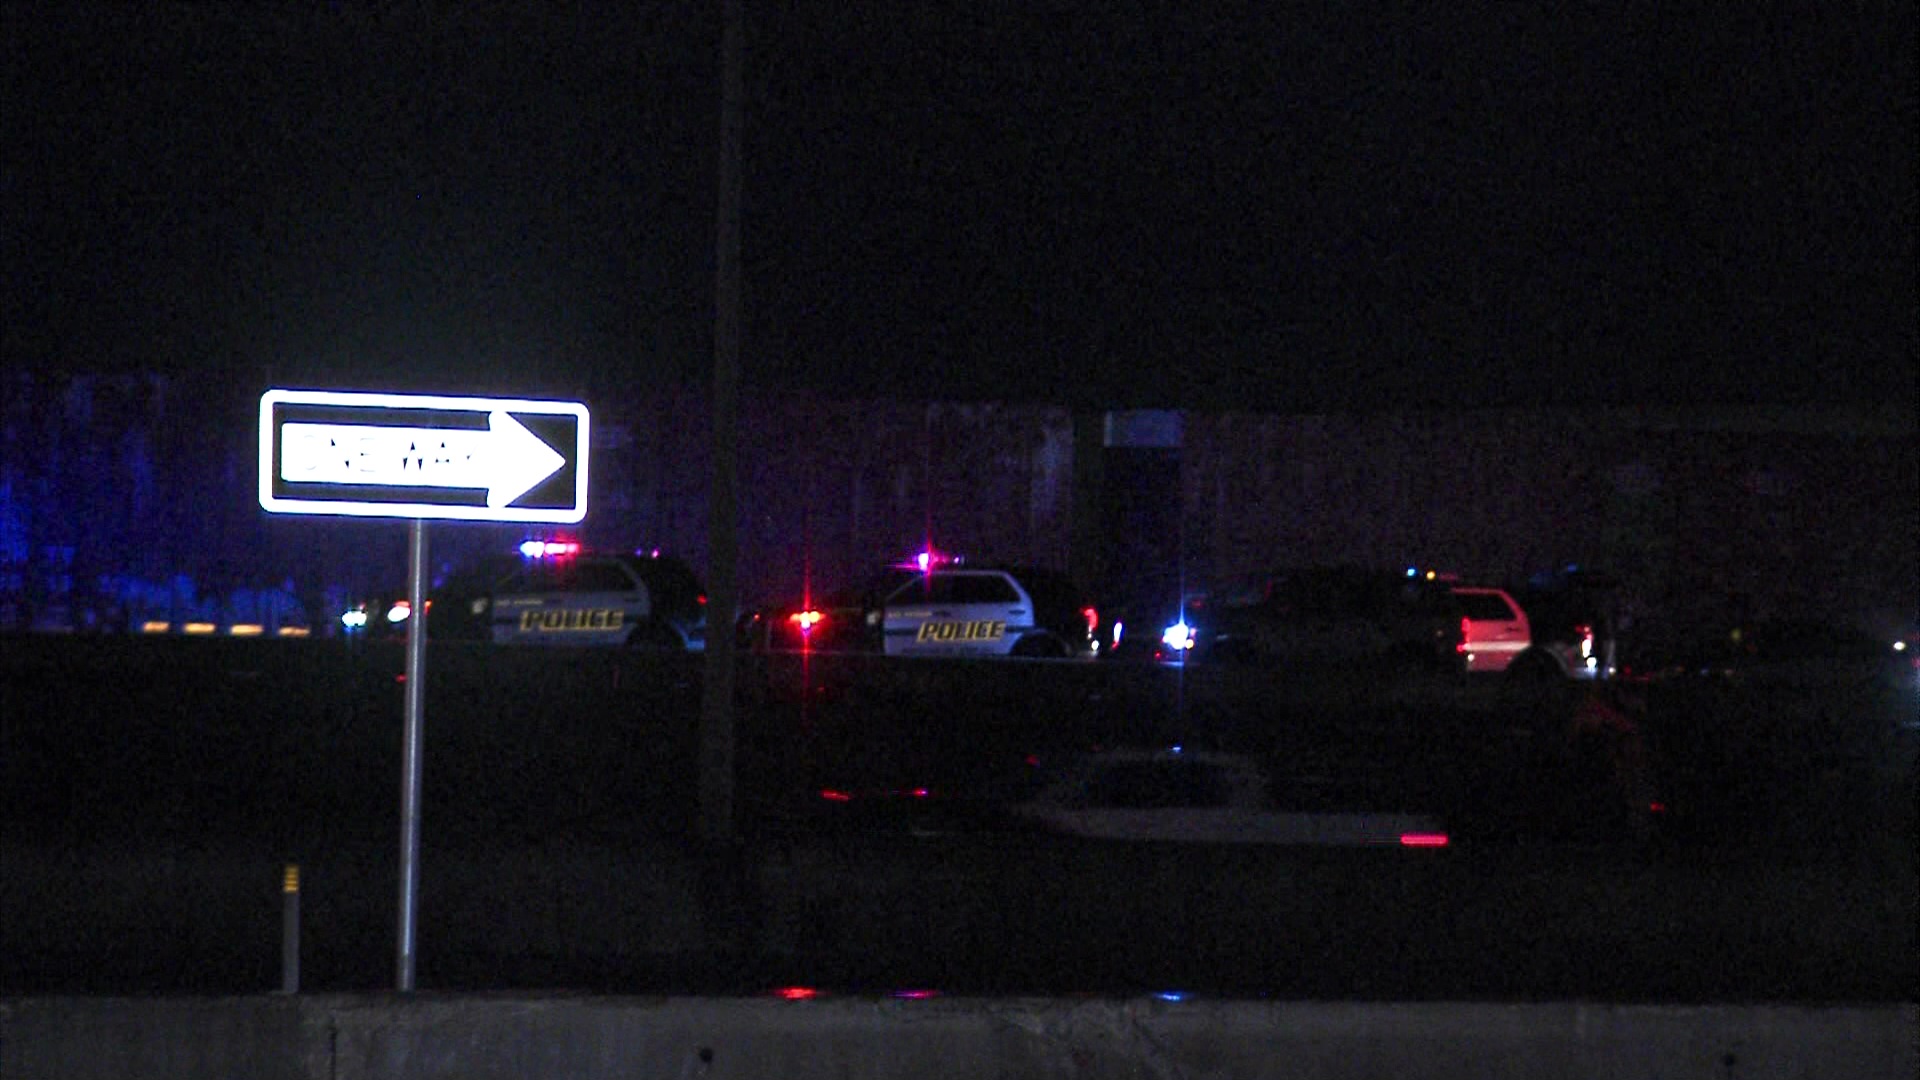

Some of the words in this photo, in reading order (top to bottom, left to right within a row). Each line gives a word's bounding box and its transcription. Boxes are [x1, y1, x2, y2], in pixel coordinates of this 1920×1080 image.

[301, 435, 376, 473] NE
[519, 608, 625, 632] POLICE
[916, 620, 1006, 643] POLICE
